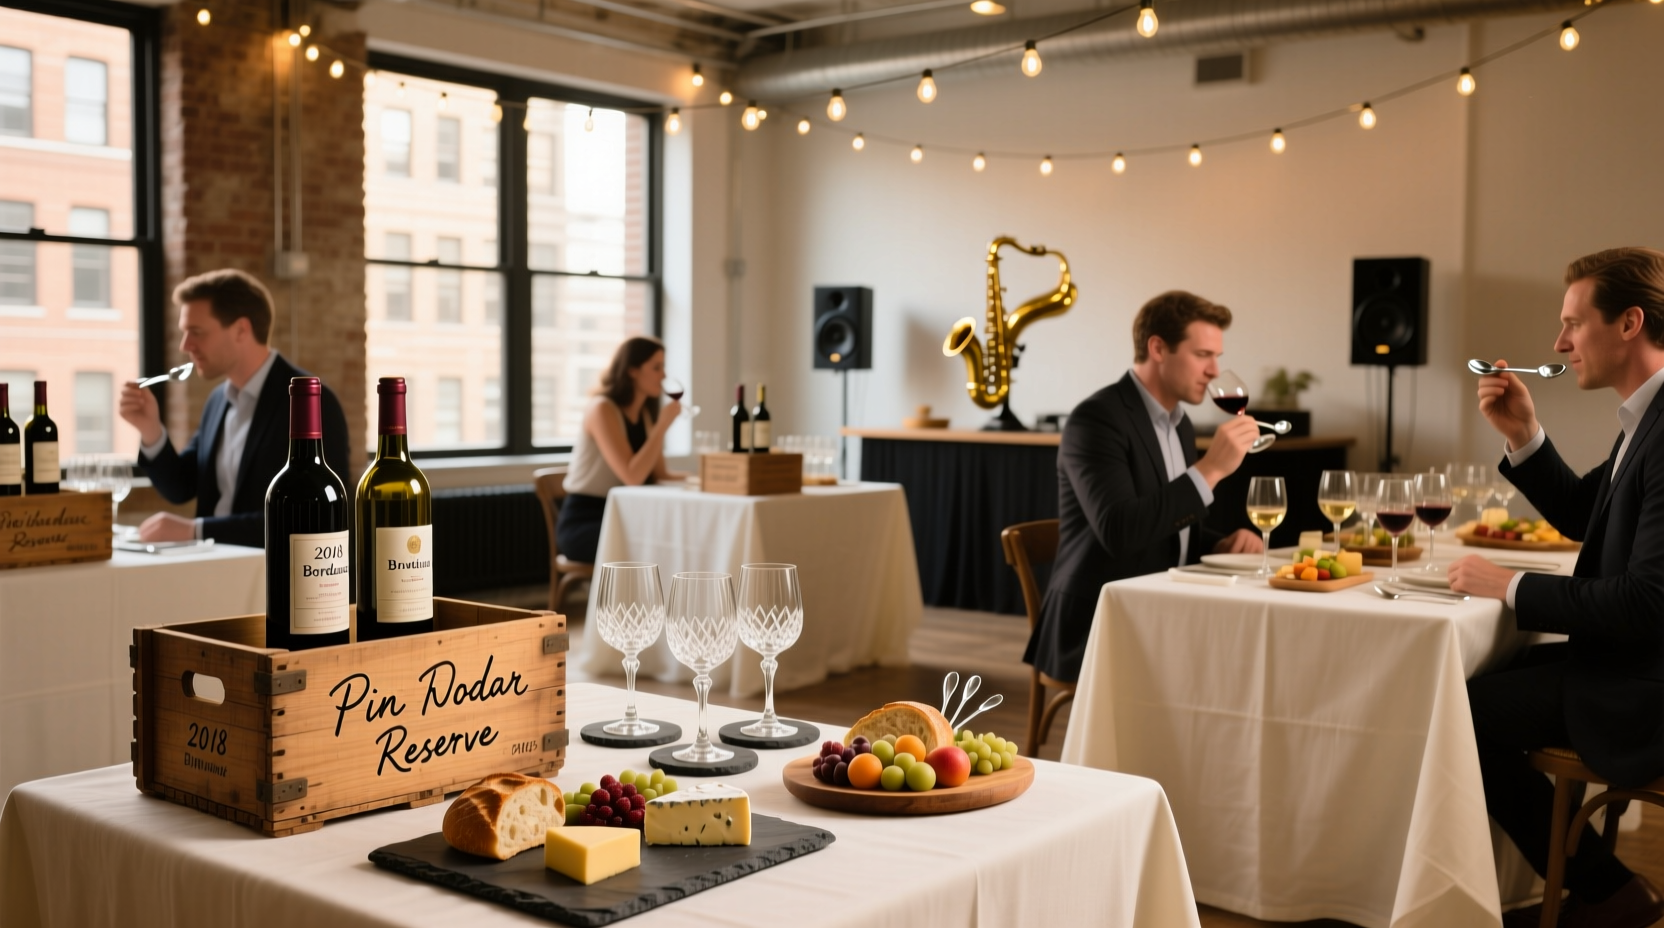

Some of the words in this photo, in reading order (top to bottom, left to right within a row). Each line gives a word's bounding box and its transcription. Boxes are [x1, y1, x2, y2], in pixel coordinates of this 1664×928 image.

[314, 544, 343, 560] 2018
[329, 672, 407, 738] Pin
[187, 722, 228, 756] 2018
[375, 724, 500, 776] Reserve
